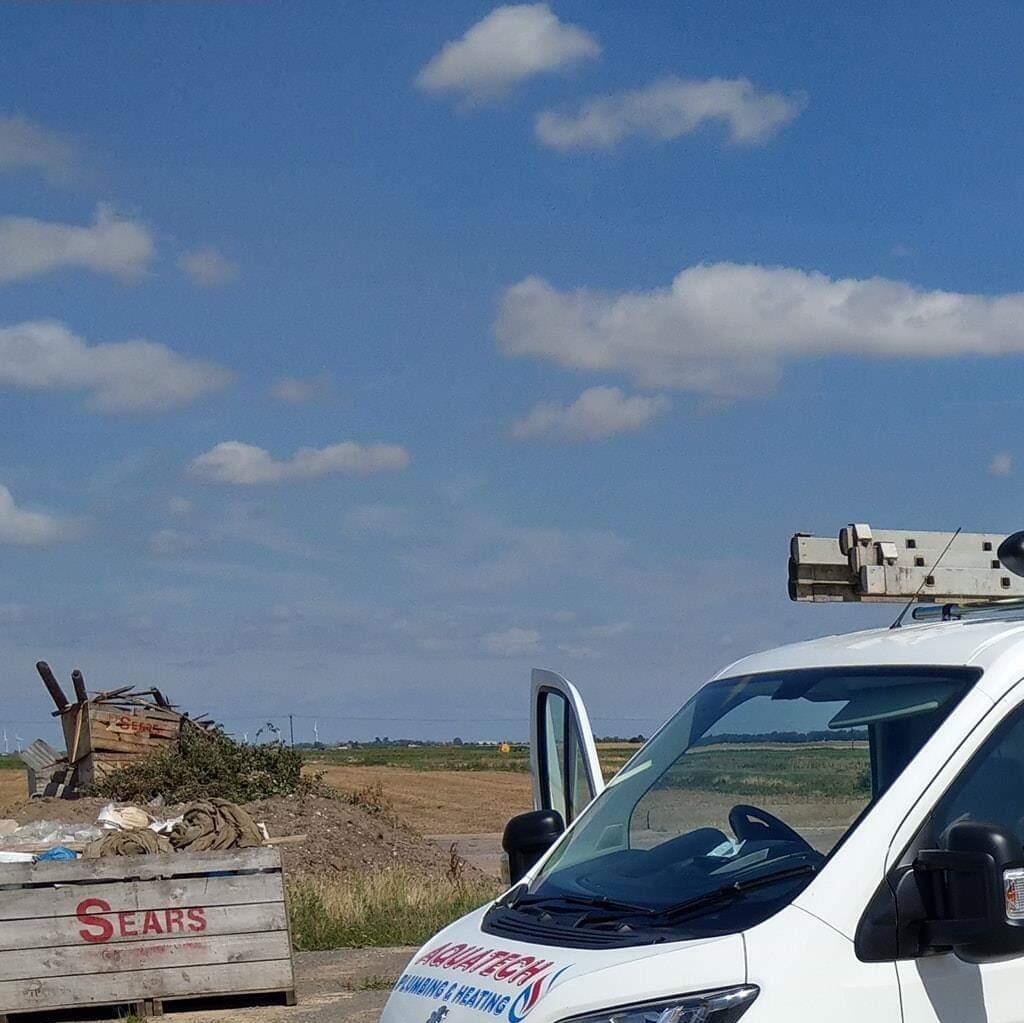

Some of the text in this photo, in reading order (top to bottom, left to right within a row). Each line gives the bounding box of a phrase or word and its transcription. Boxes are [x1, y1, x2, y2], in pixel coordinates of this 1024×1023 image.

[75, 897, 208, 944] SEARS
[414, 942, 555, 987] AQUATECH
[452, 984, 512, 1017] HEATING
